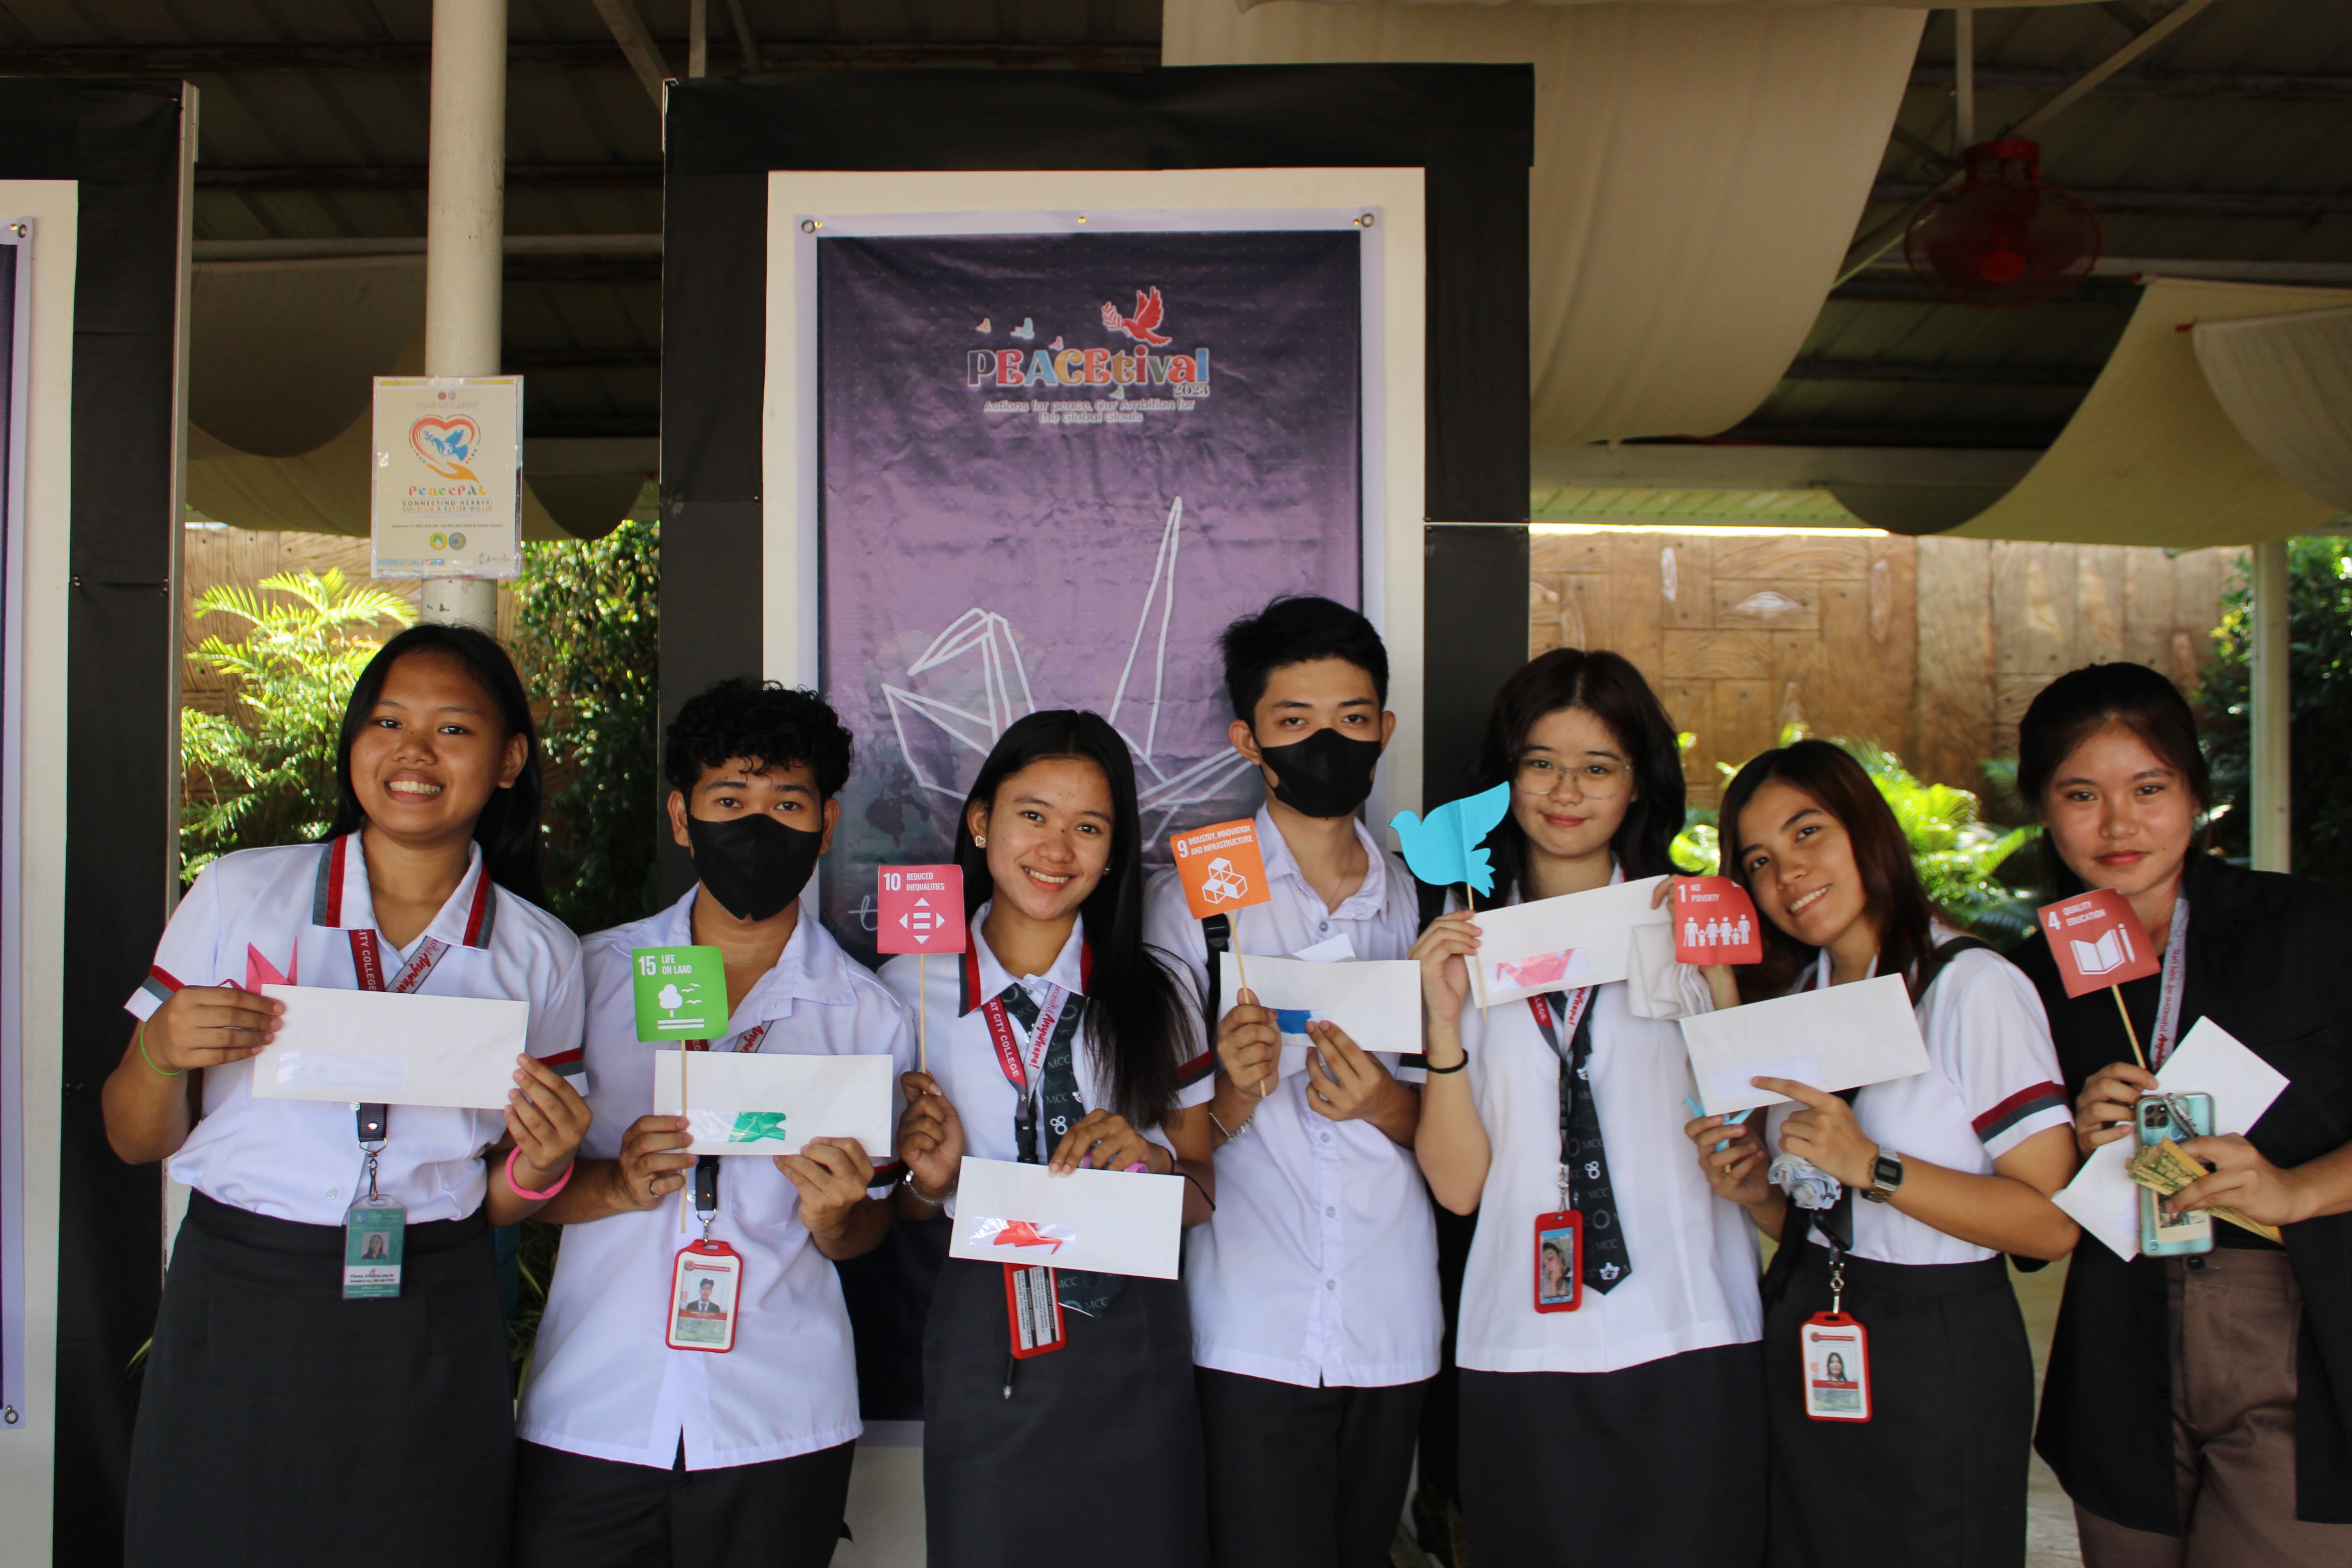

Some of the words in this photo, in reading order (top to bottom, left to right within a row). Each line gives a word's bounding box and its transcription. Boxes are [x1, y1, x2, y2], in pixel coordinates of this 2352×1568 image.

[967, 345, 1210, 387] PEACEtival
[1173, 384, 1210, 397] 2023
[984, 400, 1030, 412] Actions
[1031, 399, 1050, 412] for
[1094, 399, 1118, 411] Our
[1119, 398, 1176, 411] Ambition
[1177, 398, 1196, 410] for
[1039, 412, 1060, 423] the
[1061, 411, 1103, 424] Global
[1188, 832, 1217, 845] INDUSTRY,
[1217, 825, 1250, 838] INNOVATION
[1177, 840, 1189, 858] 9
[1191, 847, 1203, 856] AND
[1203, 835, 1254, 852] INFRASTRUCTURE
[884, 873, 901, 891] 10
[906, 872, 933, 880] REDUCED
[906, 883, 945, 891] INEQUALITIES
[1678, 884, 1686, 903] 1
[1691, 893, 1720, 902] POVERTY
[2062, 900, 2092, 916] QUALITY
[2048, 911, 2062, 930] 4
[2066, 909, 2106, 927] EDUCATION
[358, 930, 369, 947] ITY
[639, 955, 657, 976] 15
[661, 955, 675, 964] LIFE
[362, 950, 377, 991] COLLEGE
[662, 966, 671, 975] ON
[674, 965, 692, 974] LAND
[1046, 985, 1062, 1014] uccessful
[993, 1013, 1006, 1033] CITY
[1000, 1035, 1020, 1077] COLLEGE
[1047, 1054, 1071, 1069] MCC
[1045, 1092, 1069, 1105] MCC
[1588, 1187, 1610, 1199] MCC
[1595, 1239, 1618, 1249] MCC
[1084, 1297, 1108, 1310] MCC
